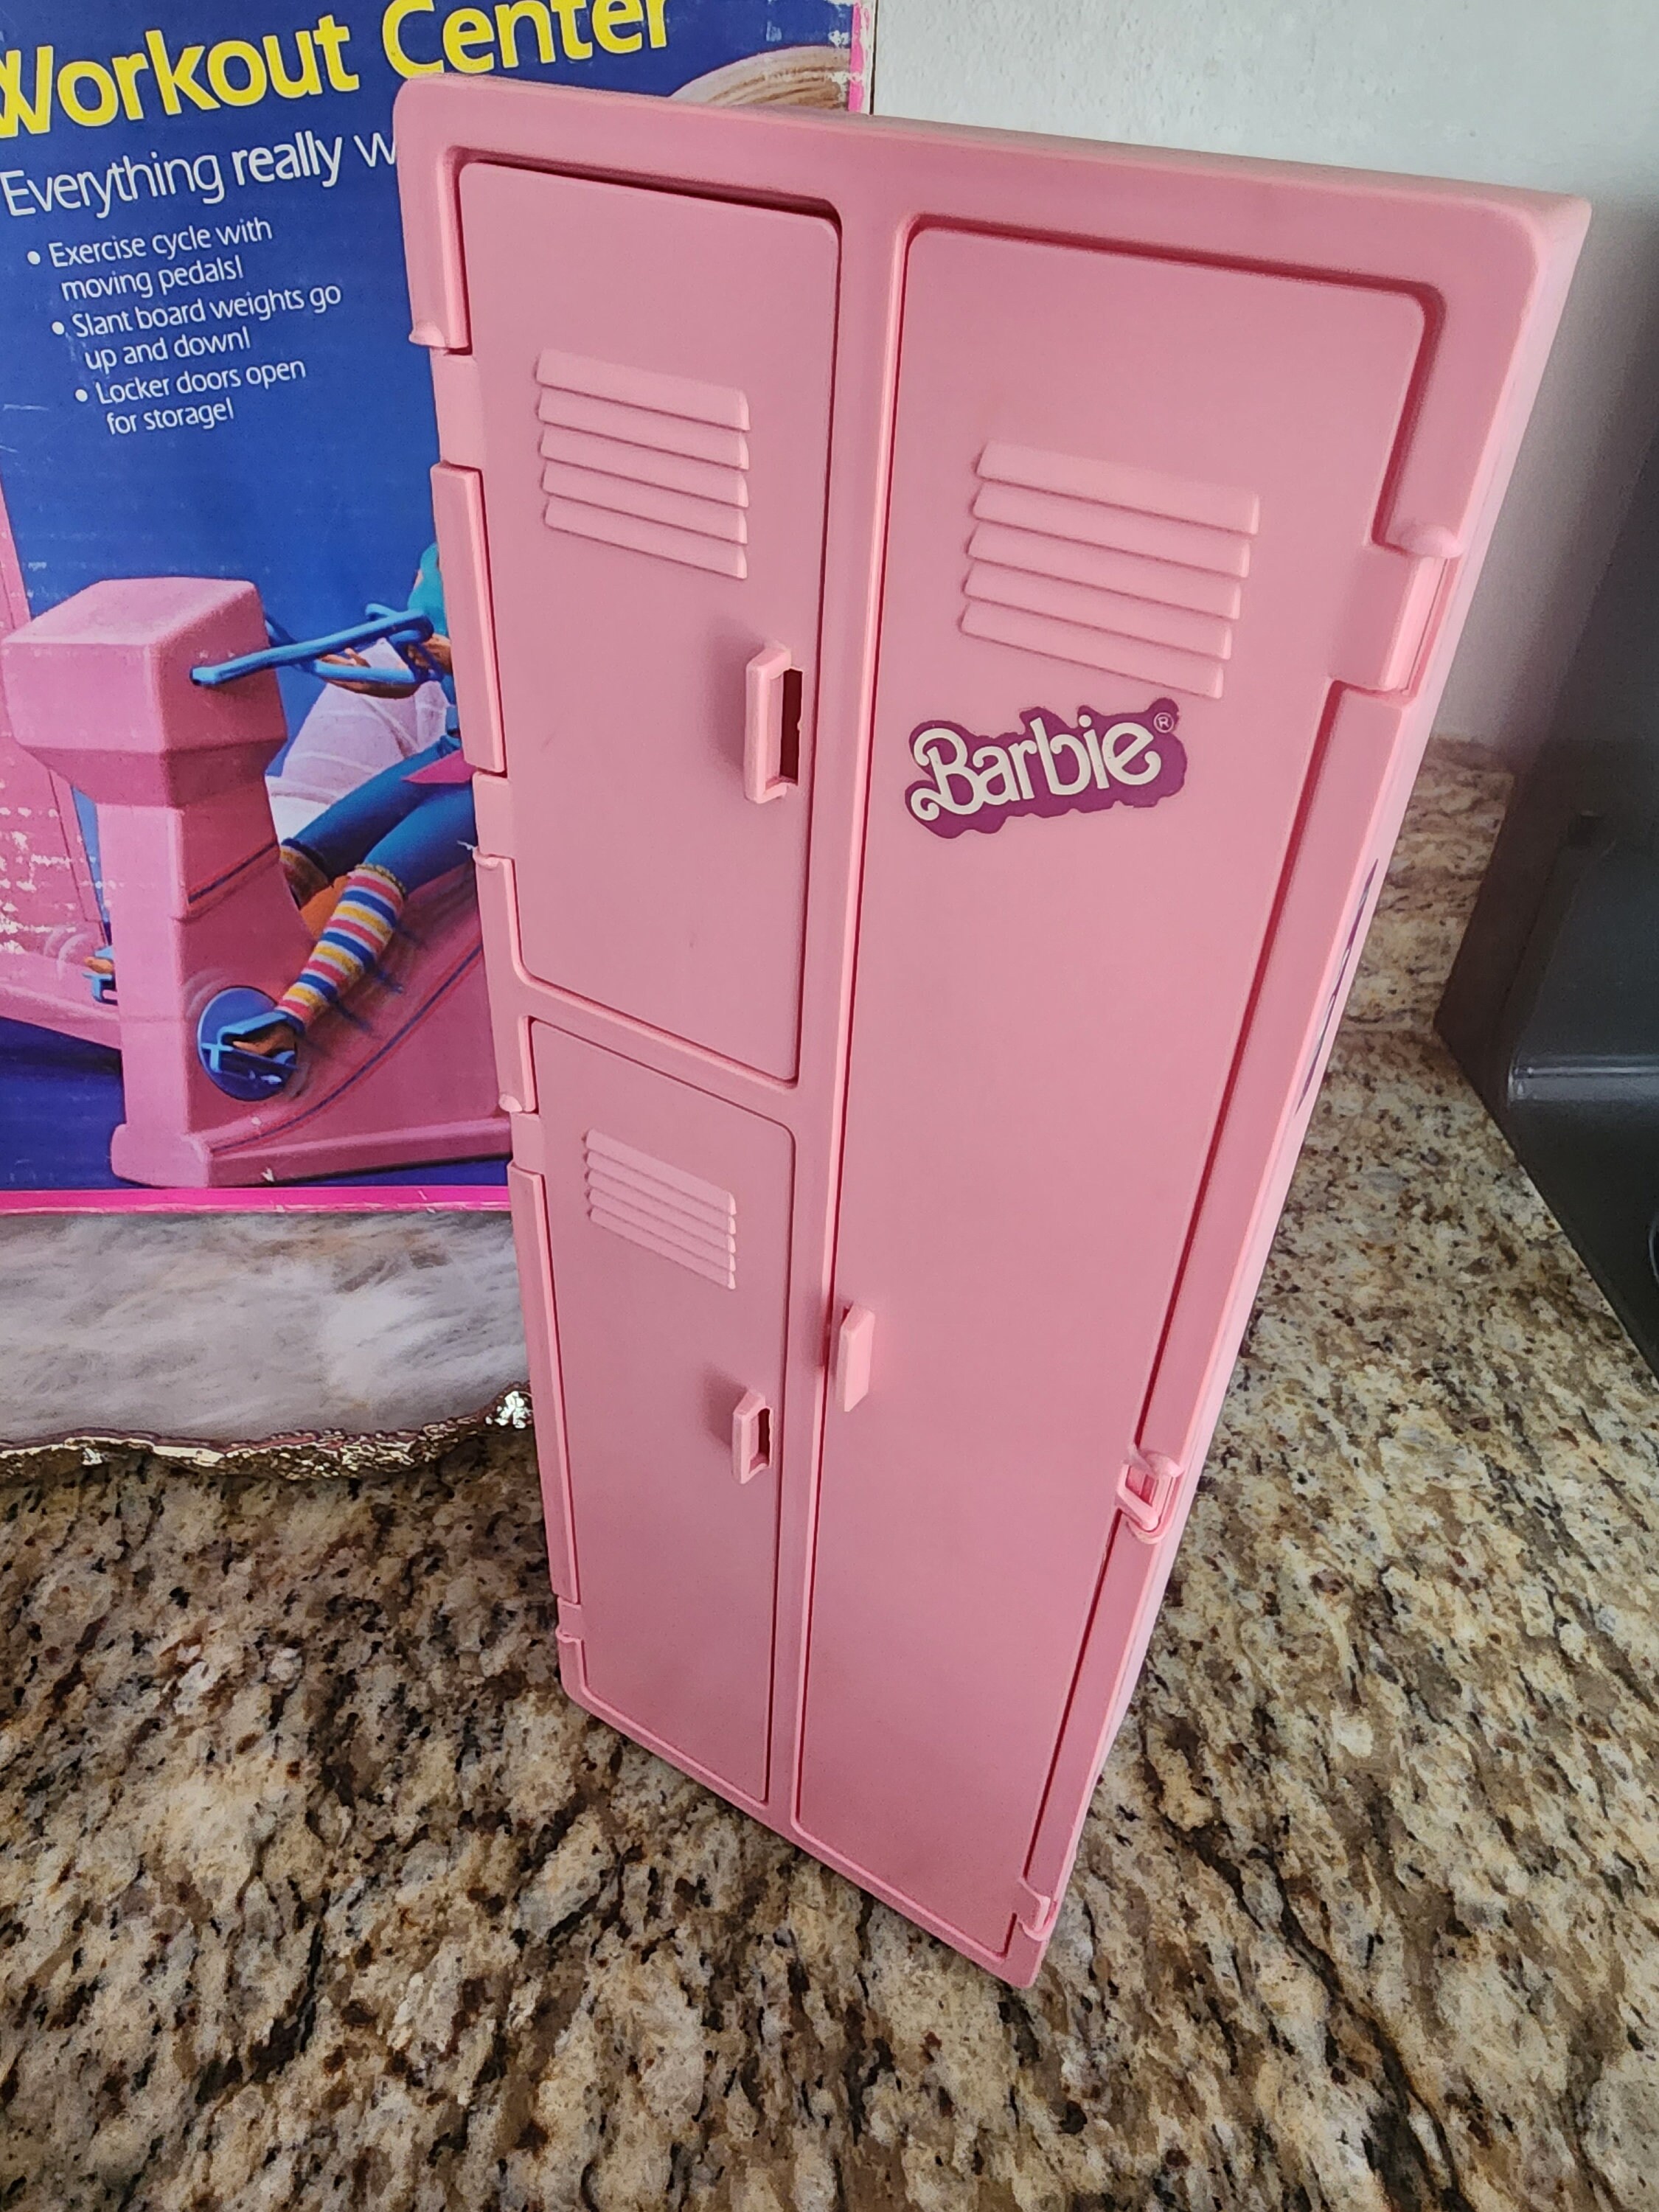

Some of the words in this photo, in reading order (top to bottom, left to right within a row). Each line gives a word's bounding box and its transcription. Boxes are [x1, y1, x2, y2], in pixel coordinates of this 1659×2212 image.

[0, 14, 360, 139] Workout
[380, 0, 669, 80] Center
[1, 150, 223, 219] Everything
[232, 131, 343, 187] really
[48, 236, 146, 267] Exercise
[151, 226, 211, 260] cycle
[215, 216, 274, 244] with
[60, 268, 153, 301] moving
[72, 310, 133, 338] Slant
[138, 298, 206, 330] board
[209, 288, 305, 323] weights
[310, 283, 342, 314] go
[85, 348, 116, 374] up
[122, 336, 170, 366] and
[95, 375, 170, 405] Locker
[175, 365, 242, 394] doors
[246, 360, 306, 389] open
[107, 412, 139, 436] for
